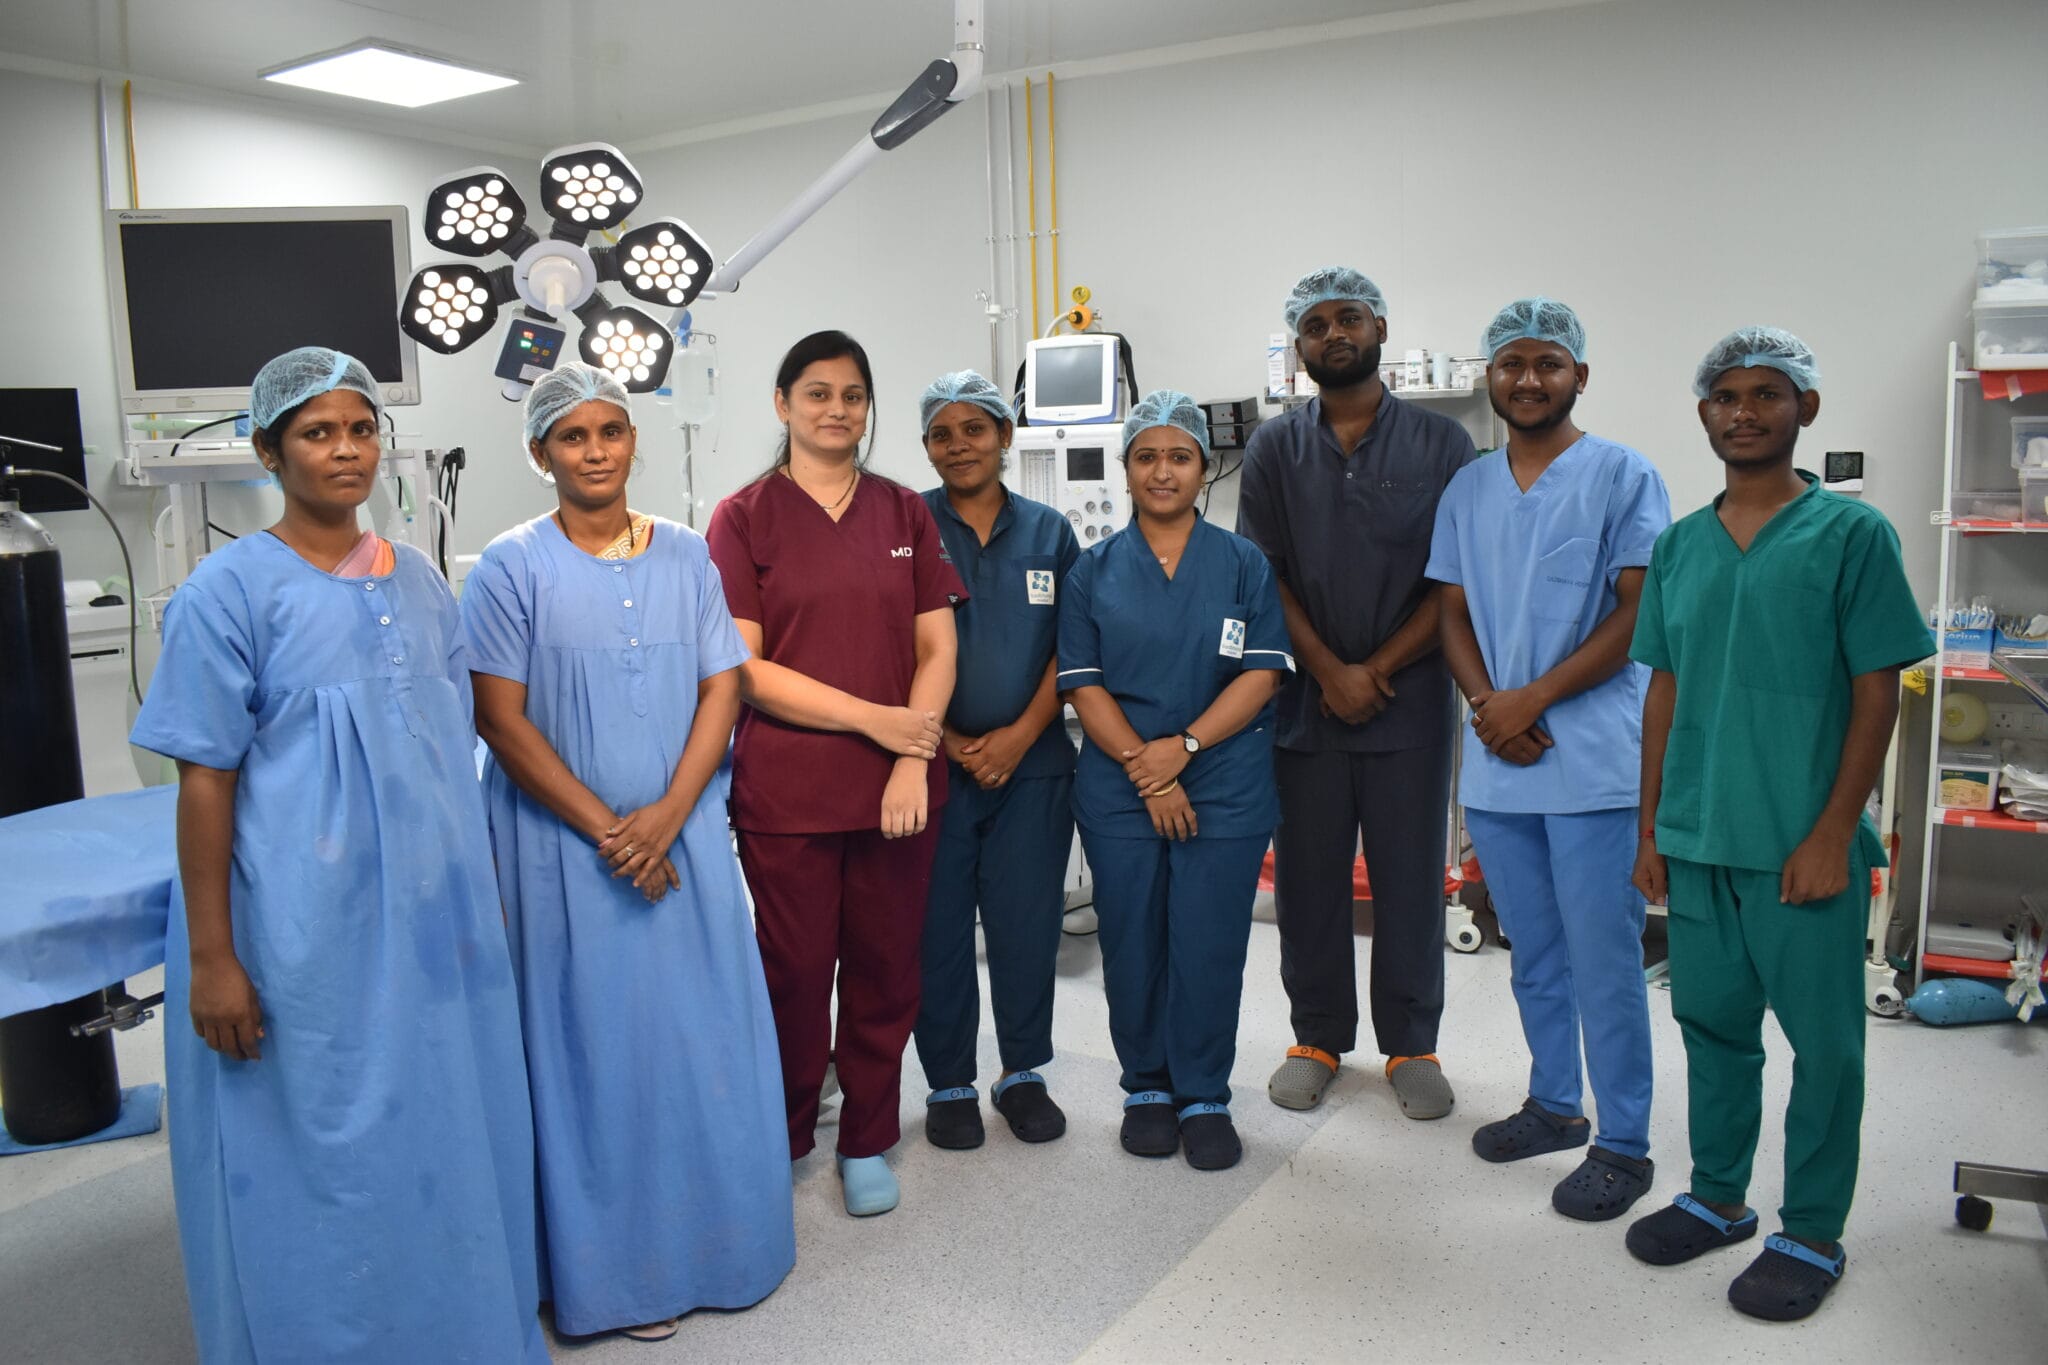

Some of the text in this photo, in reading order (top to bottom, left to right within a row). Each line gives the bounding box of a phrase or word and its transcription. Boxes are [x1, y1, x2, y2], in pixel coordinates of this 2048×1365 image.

[890, 547, 912, 558] MD
[1019, 1072, 1034, 1080] OT
[951, 1088, 968, 1098] OT
[1143, 1093, 1158, 1102] OT
[1203, 1104, 1217, 1112] OT
[1676, 1196, 1696, 1210] OT
[1776, 1239, 1799, 1254] OT
